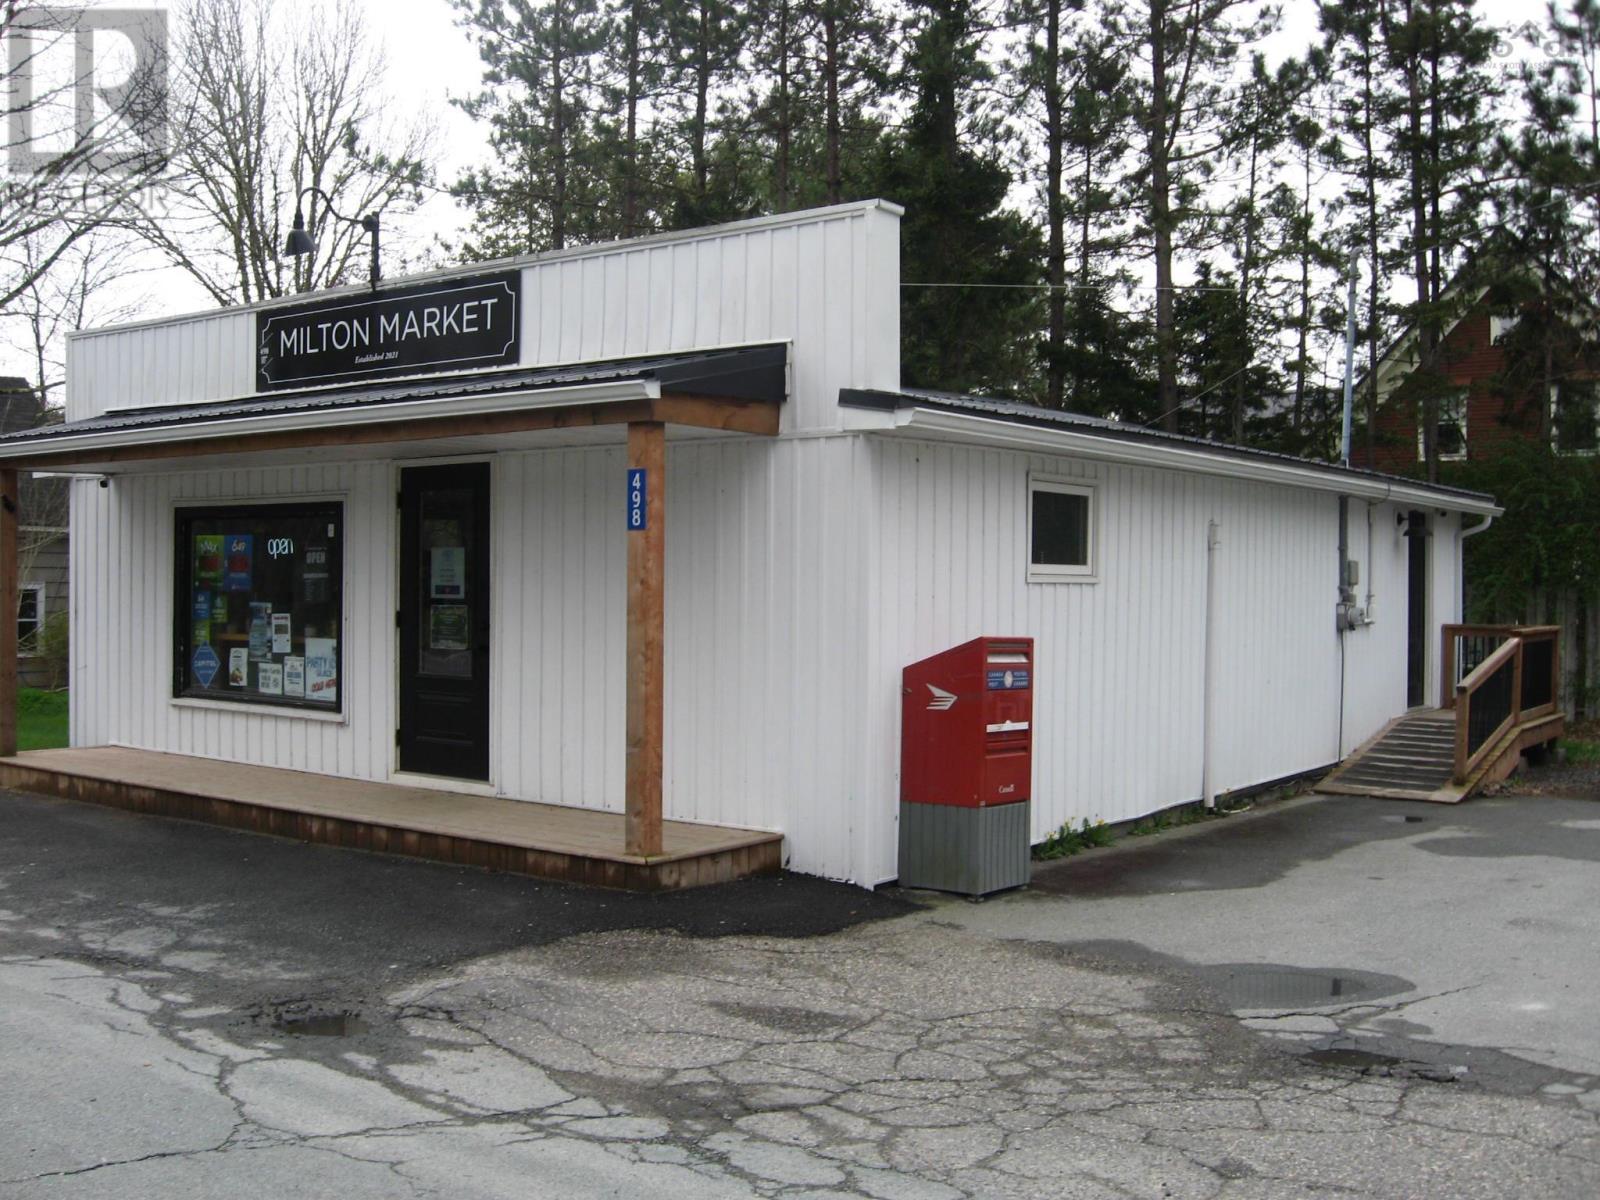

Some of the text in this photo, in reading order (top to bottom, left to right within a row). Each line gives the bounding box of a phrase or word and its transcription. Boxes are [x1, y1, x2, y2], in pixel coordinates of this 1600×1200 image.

[280, 316, 369, 358] MILTON
[379, 298, 499, 344] MARKET
[632, 472, 641, 526] 498
[267, 538, 294, 560] open
